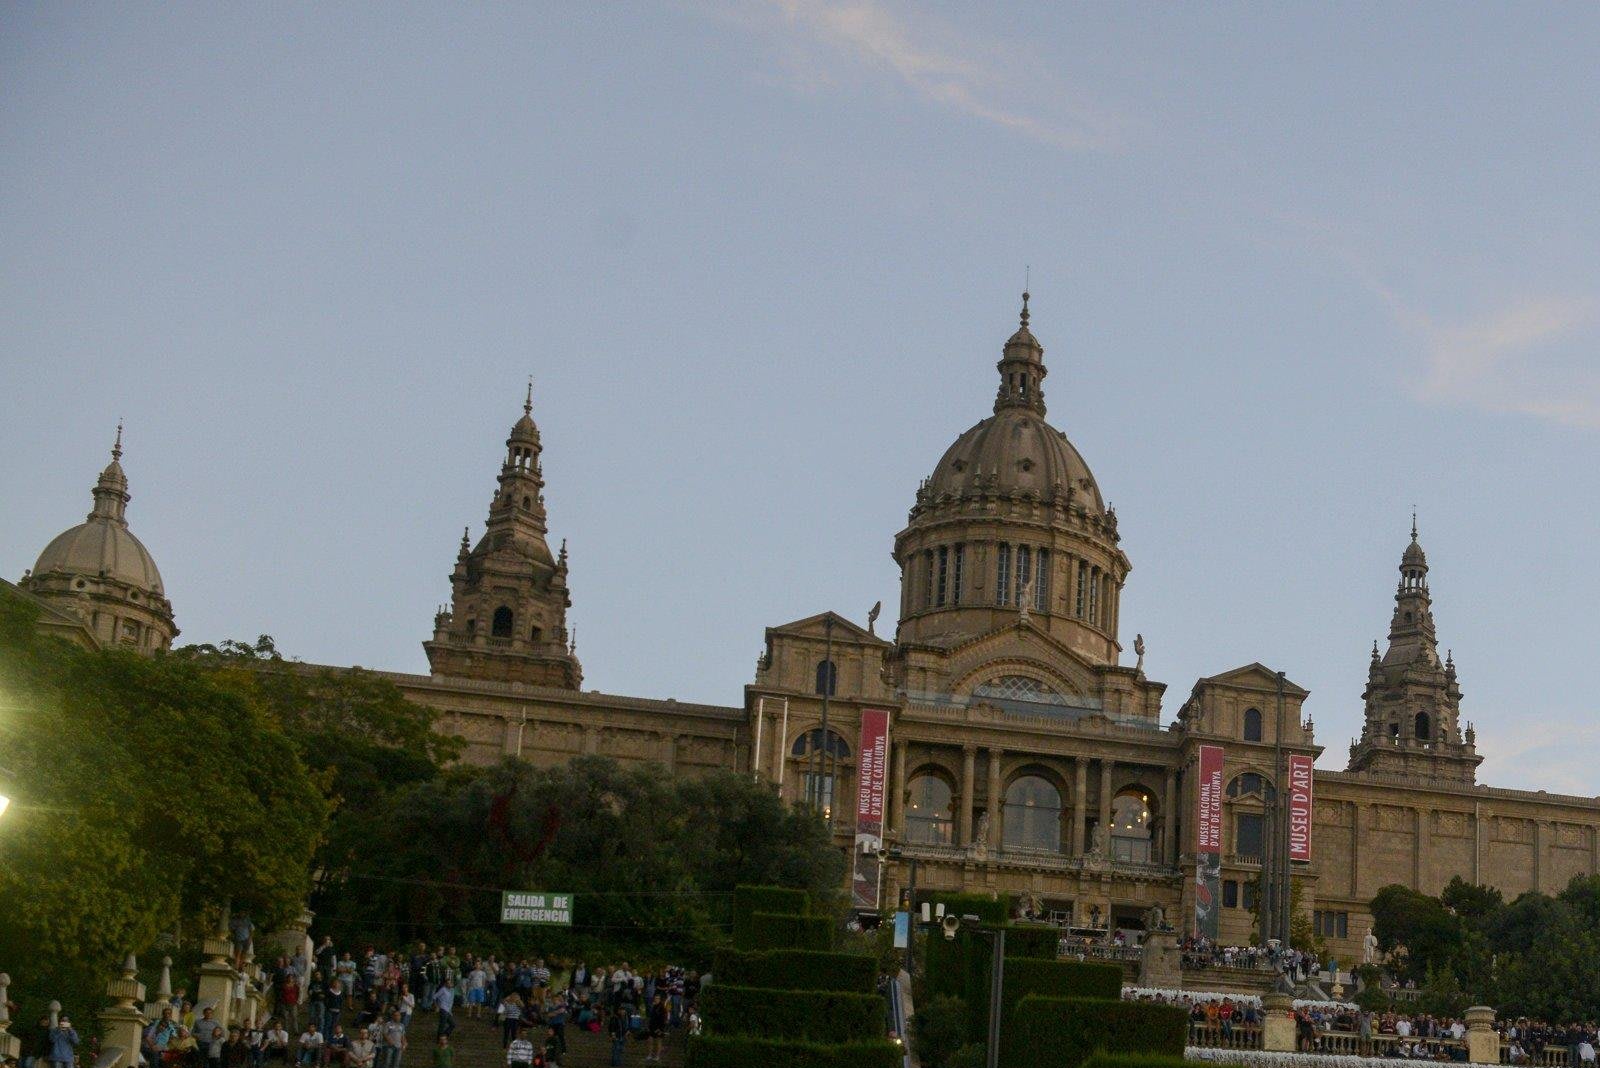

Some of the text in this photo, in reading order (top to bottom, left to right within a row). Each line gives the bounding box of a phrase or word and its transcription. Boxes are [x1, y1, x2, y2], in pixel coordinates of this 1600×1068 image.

[873, 736, 885, 778] CATALUNYA
[859, 748, 873, 814] MUSEU NACIONAL
[872, 780, 883, 791] DE
[1211, 770, 1221, 811] CATALUNYA
[1200, 783, 1211, 846] MUSEU NACIONAL
[1211, 813, 1220, 823] DE
[1290, 762, 1309, 853] MUSEU D'ART
[503, 908, 570, 923] EMERGENCIA
[507, 894, 568, 908] SALIDA DE
